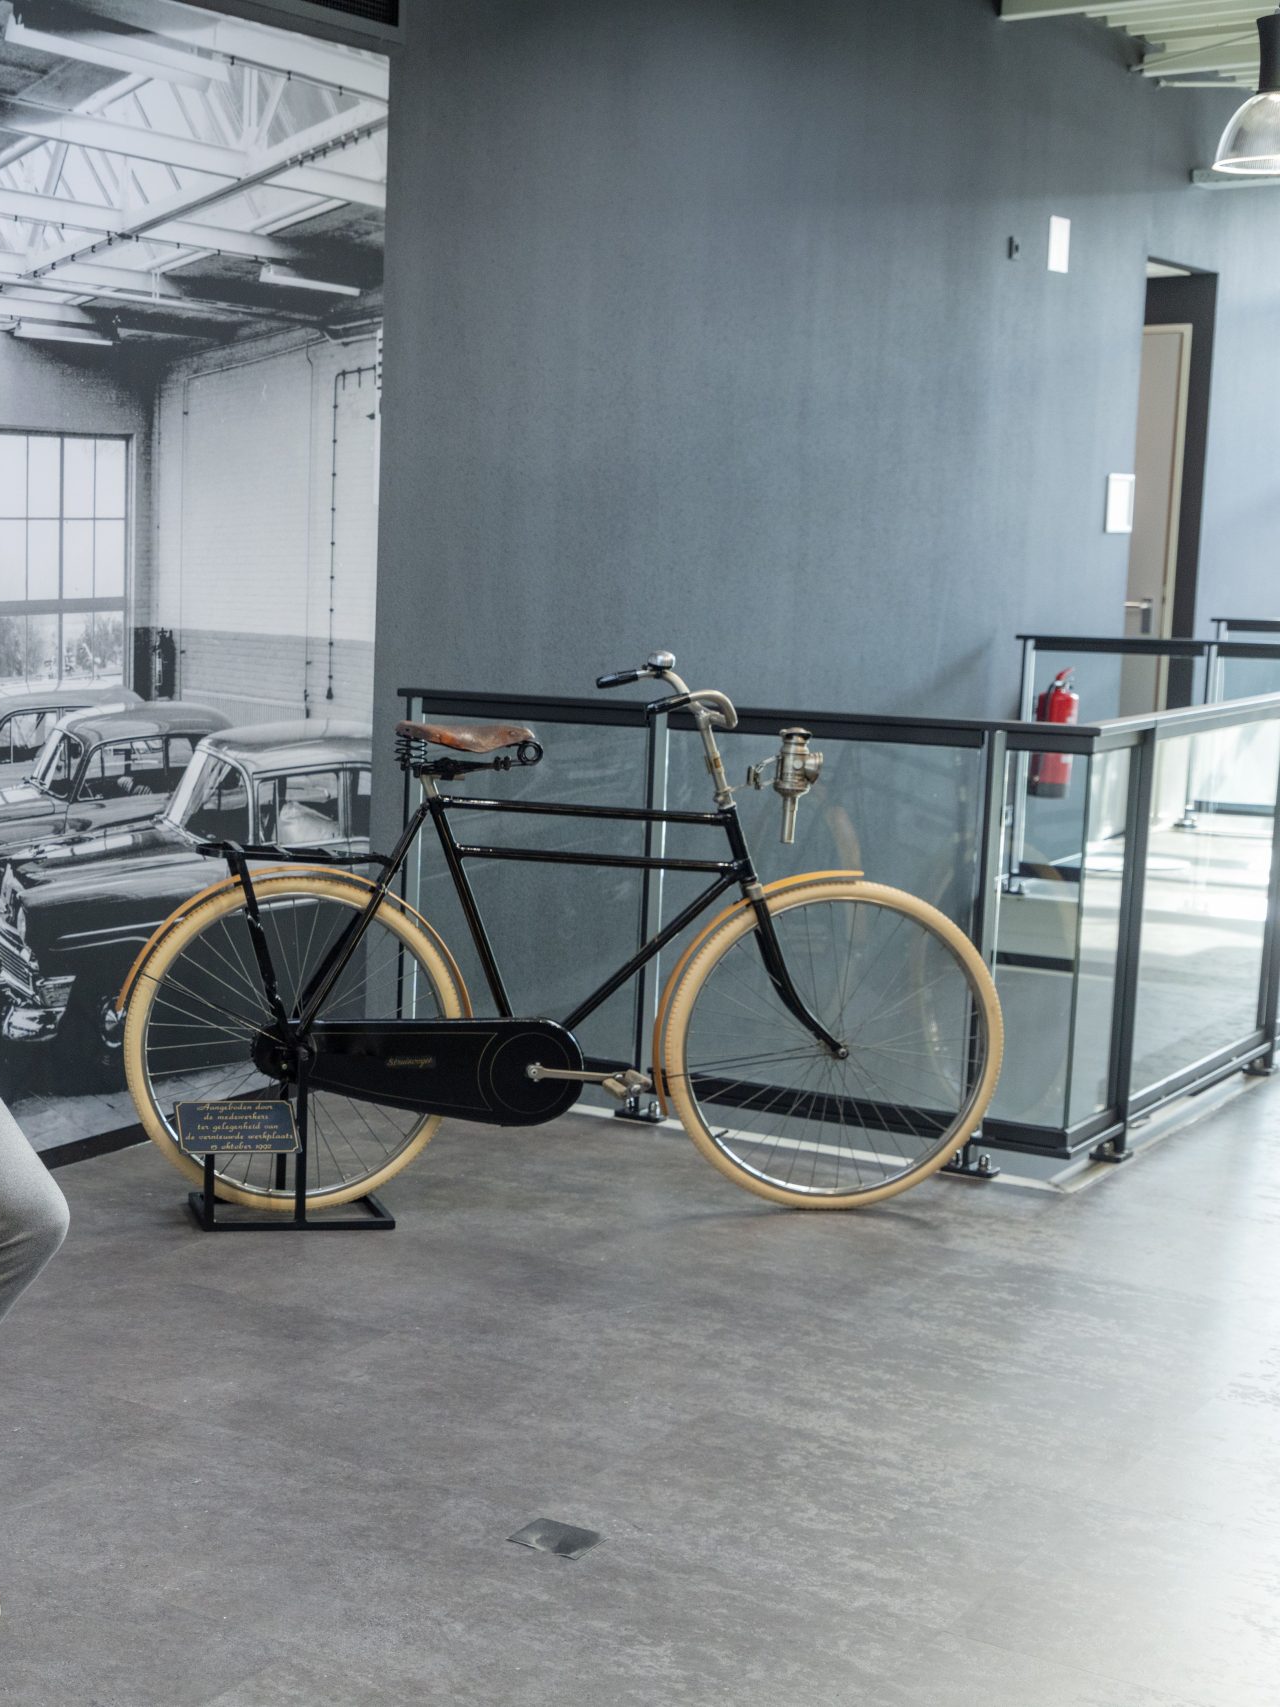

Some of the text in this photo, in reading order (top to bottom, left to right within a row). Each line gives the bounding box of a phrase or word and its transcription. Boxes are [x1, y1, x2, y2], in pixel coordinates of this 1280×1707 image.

[196, 1103, 252, 1112] Aangeboden
[217, 1112, 269, 1120] medewerkers
[212, 1121, 261, 1132] gelegenheid
[185, 1131, 293, 1141] de vernieuwde werkplaats
[221, 1142, 252, 1150] oktober
